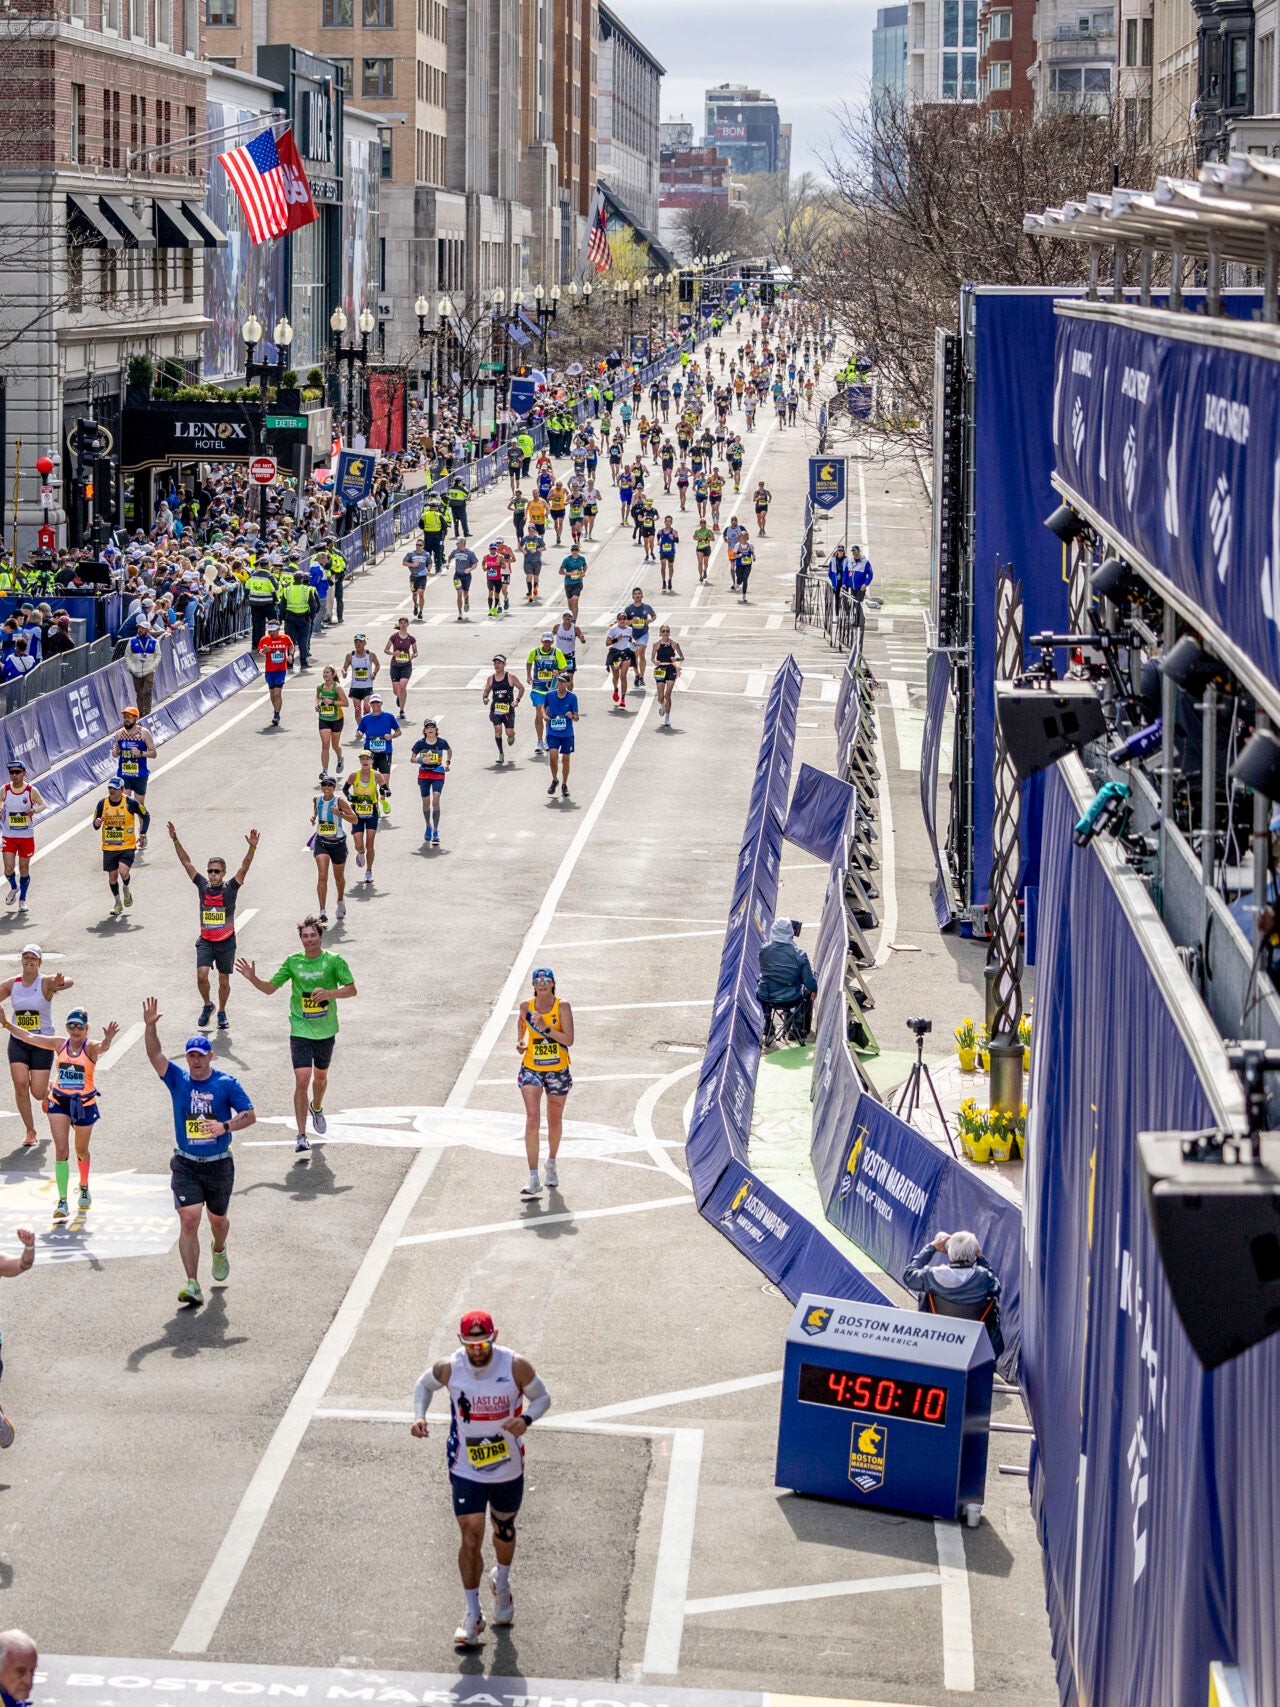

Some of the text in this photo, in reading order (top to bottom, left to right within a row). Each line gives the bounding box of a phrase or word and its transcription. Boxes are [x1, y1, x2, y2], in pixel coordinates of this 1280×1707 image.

[174, 422, 247, 439] LENOX
[275, 420, 297, 428] EXETER
[195, 440, 226, 449] HOTEL
[17, 1016, 39, 1026] 30051
[534, 1044, 558, 1056] 26248
[862, 1147, 929, 1217] BOSTON MARATHON
[837, 1315, 966, 1345] BOSTON MARATHON
[834, 1328, 919, 1347] BANK OF AMERICA
[472, 1394, 510, 1405] LAST CALL
[828, 1373, 945, 1420] 4:50:10
[470, 1442, 506, 1461] 30769
[851, 1453, 884, 1465] BOSTON
[851, 1460, 883, 1471] MARATHON
[66, 1673, 309, 1698] BOSTON
